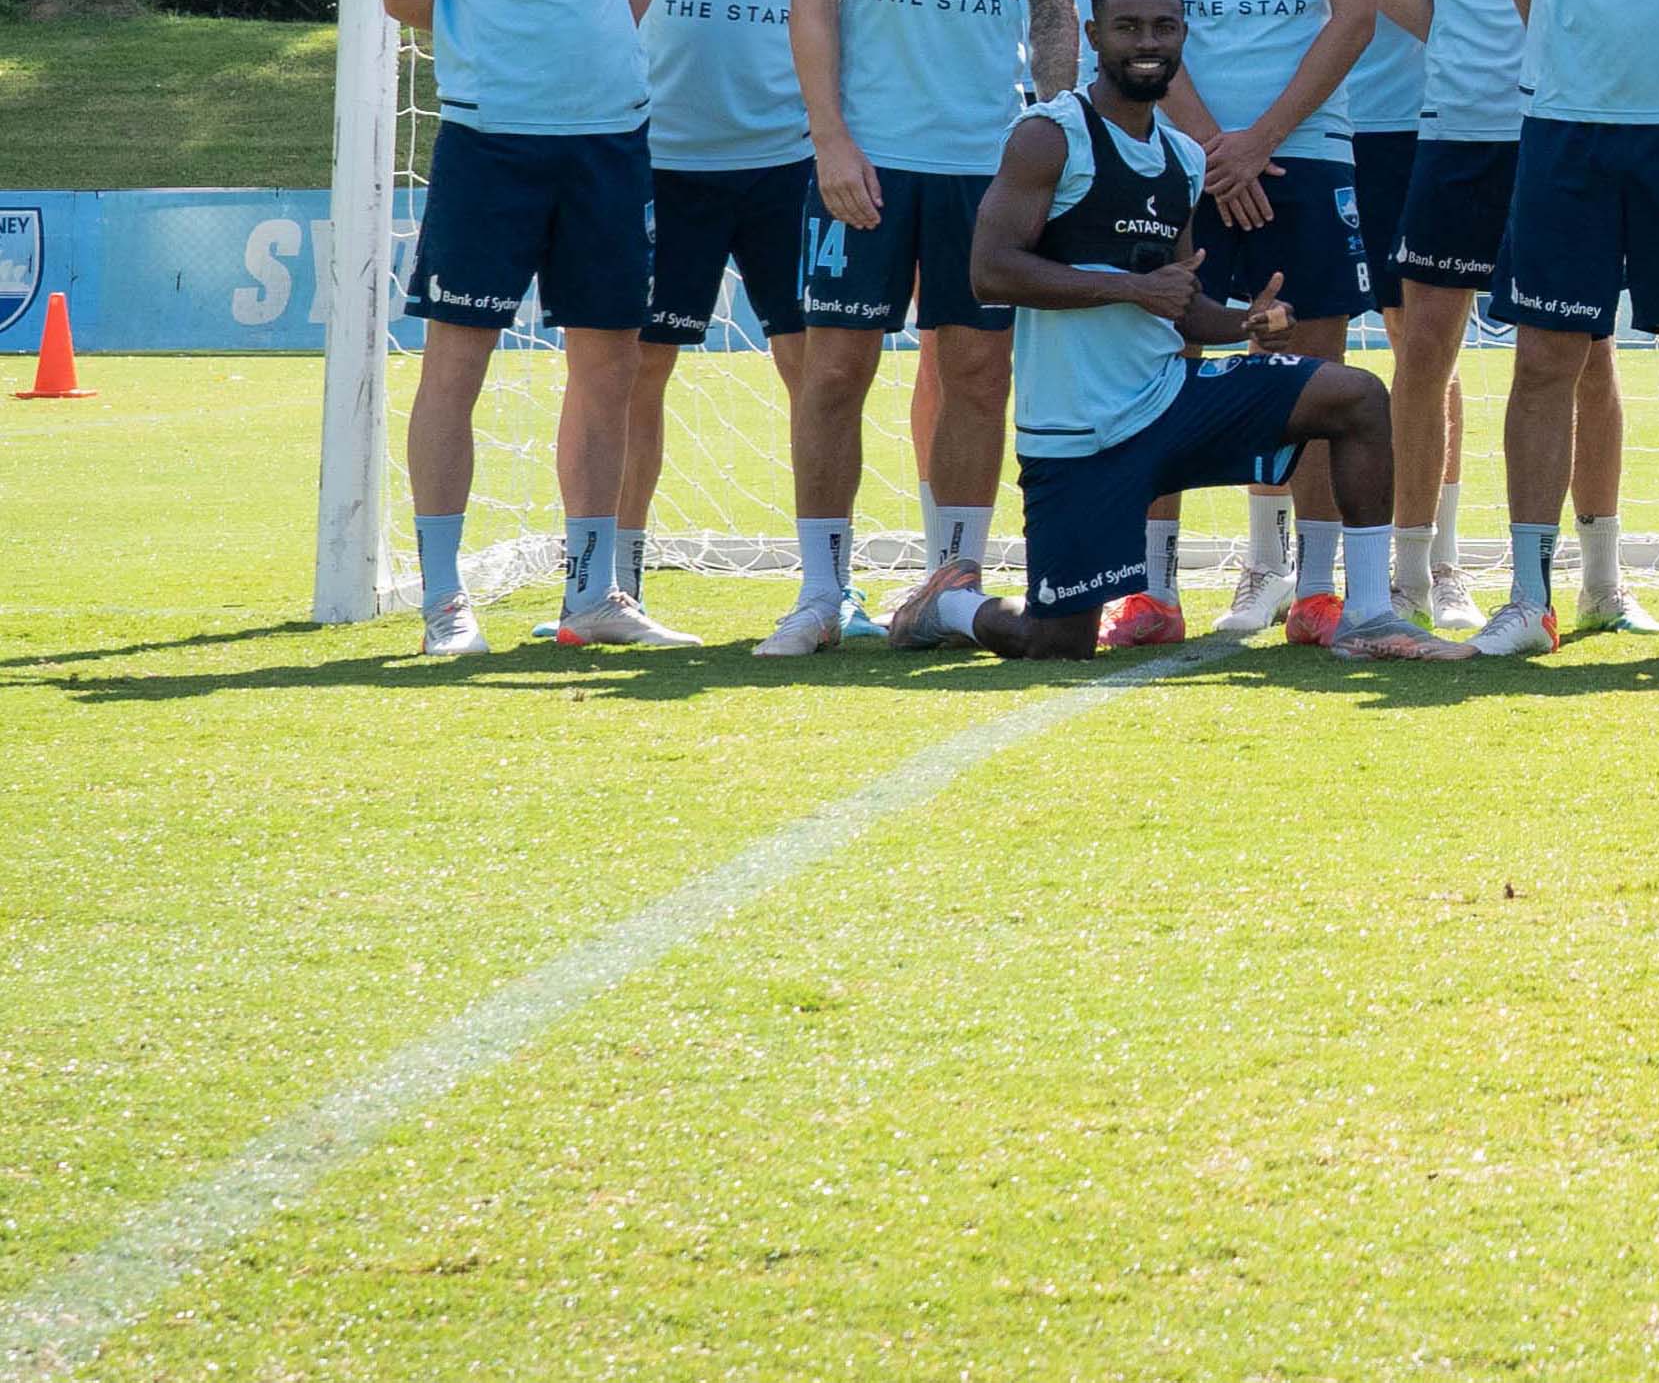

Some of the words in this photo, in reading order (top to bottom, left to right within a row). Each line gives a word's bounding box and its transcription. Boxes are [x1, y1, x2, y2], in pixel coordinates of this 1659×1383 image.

[727, 4, 790, 25] STAR
[1238, 0, 1308, 17] STAR
[0, 216, 30, 235] NEY
[1114, 218, 1180, 239] CATAPULT
[807, 217, 849, 278] 14
[1408, 250, 1435, 268] Bank
[1438, 256, 1453, 270] of
[1454, 258, 1495, 275] Sydney
[1356, 261, 1371, 293] 8
[442, 289, 472, 307] Bank
[475, 294, 489, 309] of
[491, 295, 519, 312] Sydn
[812, 298, 842, 313] Bank
[845, 301, 860, 316] of
[862, 303, 890, 319] Syd
[1519, 292, 1543, 310] Bank
[1545, 299, 1558, 313] of
[1560, 301, 1602, 320] Sydney
[653, 312, 666, 325] of
[668, 313, 707, 332] Sydney
[1057, 581, 1089, 600] Bank
[1090, 574, 1104, 591] of
[1105, 561, 1147, 586] Sydney
